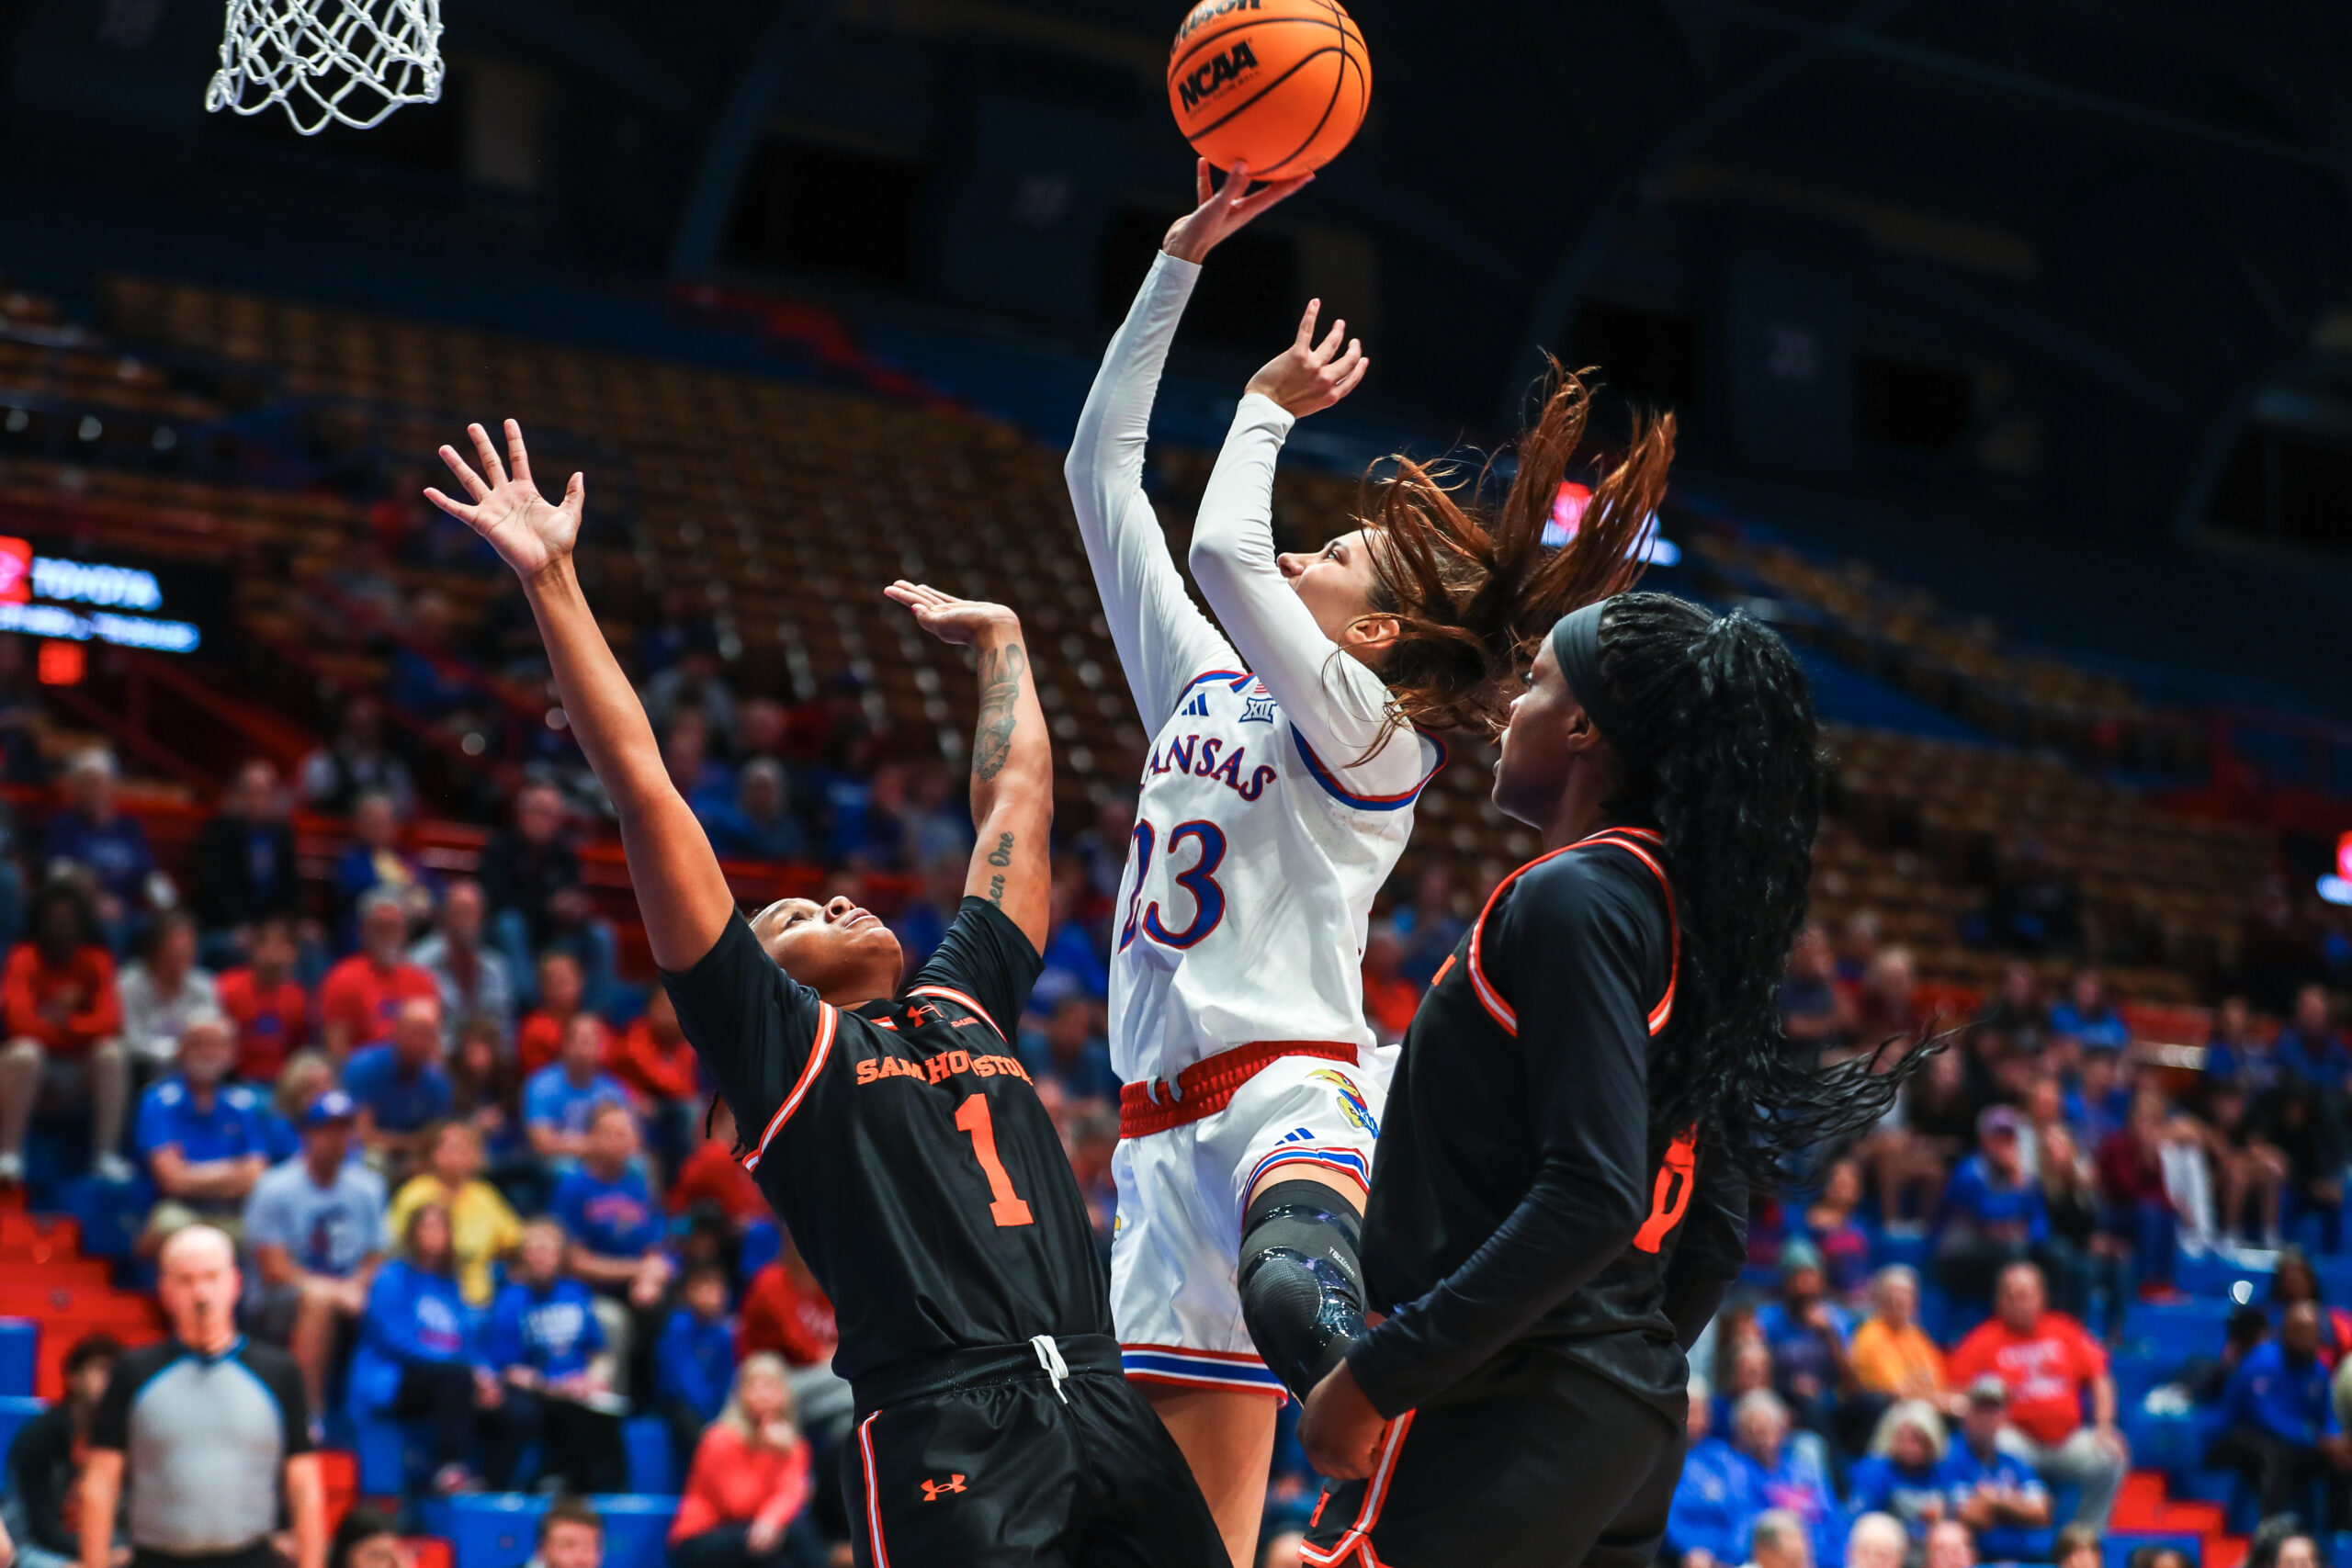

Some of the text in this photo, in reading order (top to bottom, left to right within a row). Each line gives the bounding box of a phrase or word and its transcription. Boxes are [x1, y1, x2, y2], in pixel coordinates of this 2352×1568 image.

[1178, 40, 1259, 113] NCAA
[1138, 734, 1277, 802] ANSAS
[987, 831, 1014, 867] One
[1117, 818, 1227, 954] 23
[855, 1049, 1035, 1087] SAM HOSTO
[955, 1092, 1035, 1227] 1
